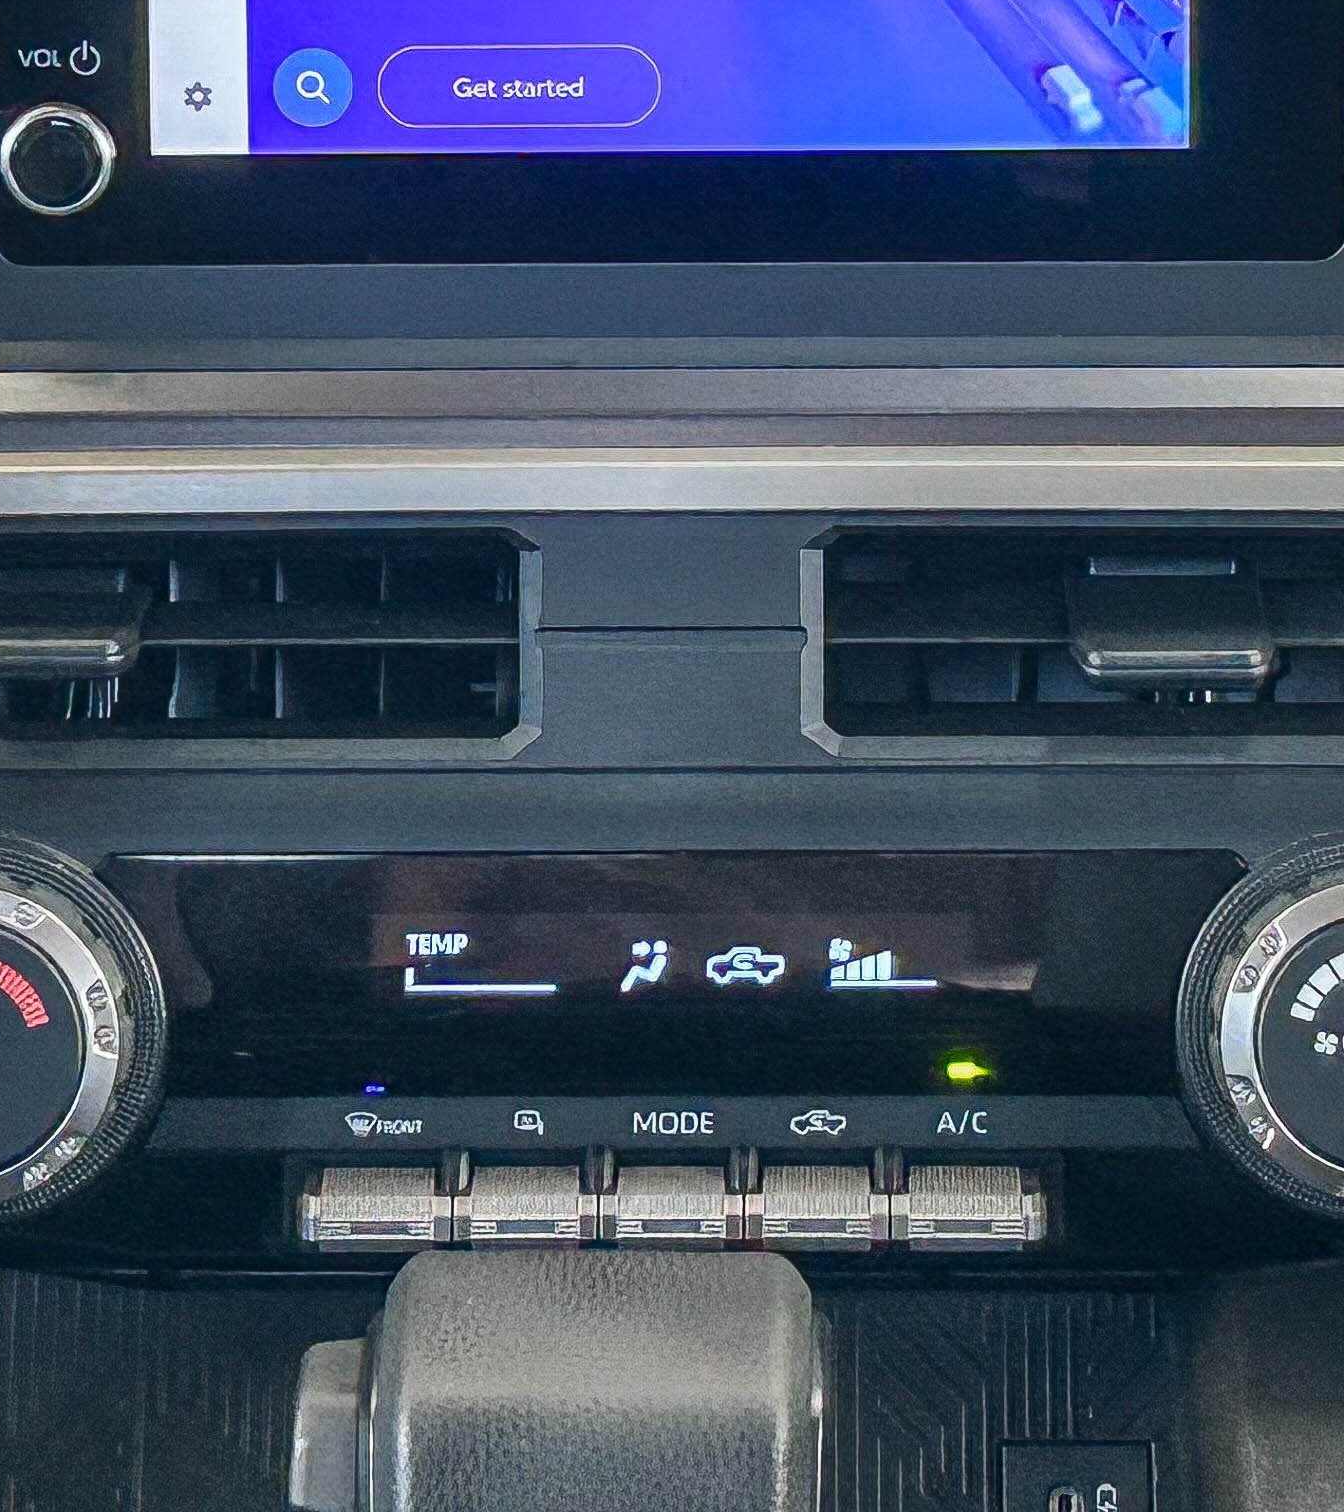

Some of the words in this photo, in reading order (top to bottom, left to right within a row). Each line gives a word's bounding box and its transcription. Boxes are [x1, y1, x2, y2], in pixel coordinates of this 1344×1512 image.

[17, 48, 62, 67] VOL
[453, 77, 498, 98] Get
[502, 75, 584, 98] started
[406, 933, 469, 956] TEMP
[376, 1119, 423, 1135] FRONT
[632, 1111, 714, 1135] MODE
[936, 1110, 987, 1135] A/C
